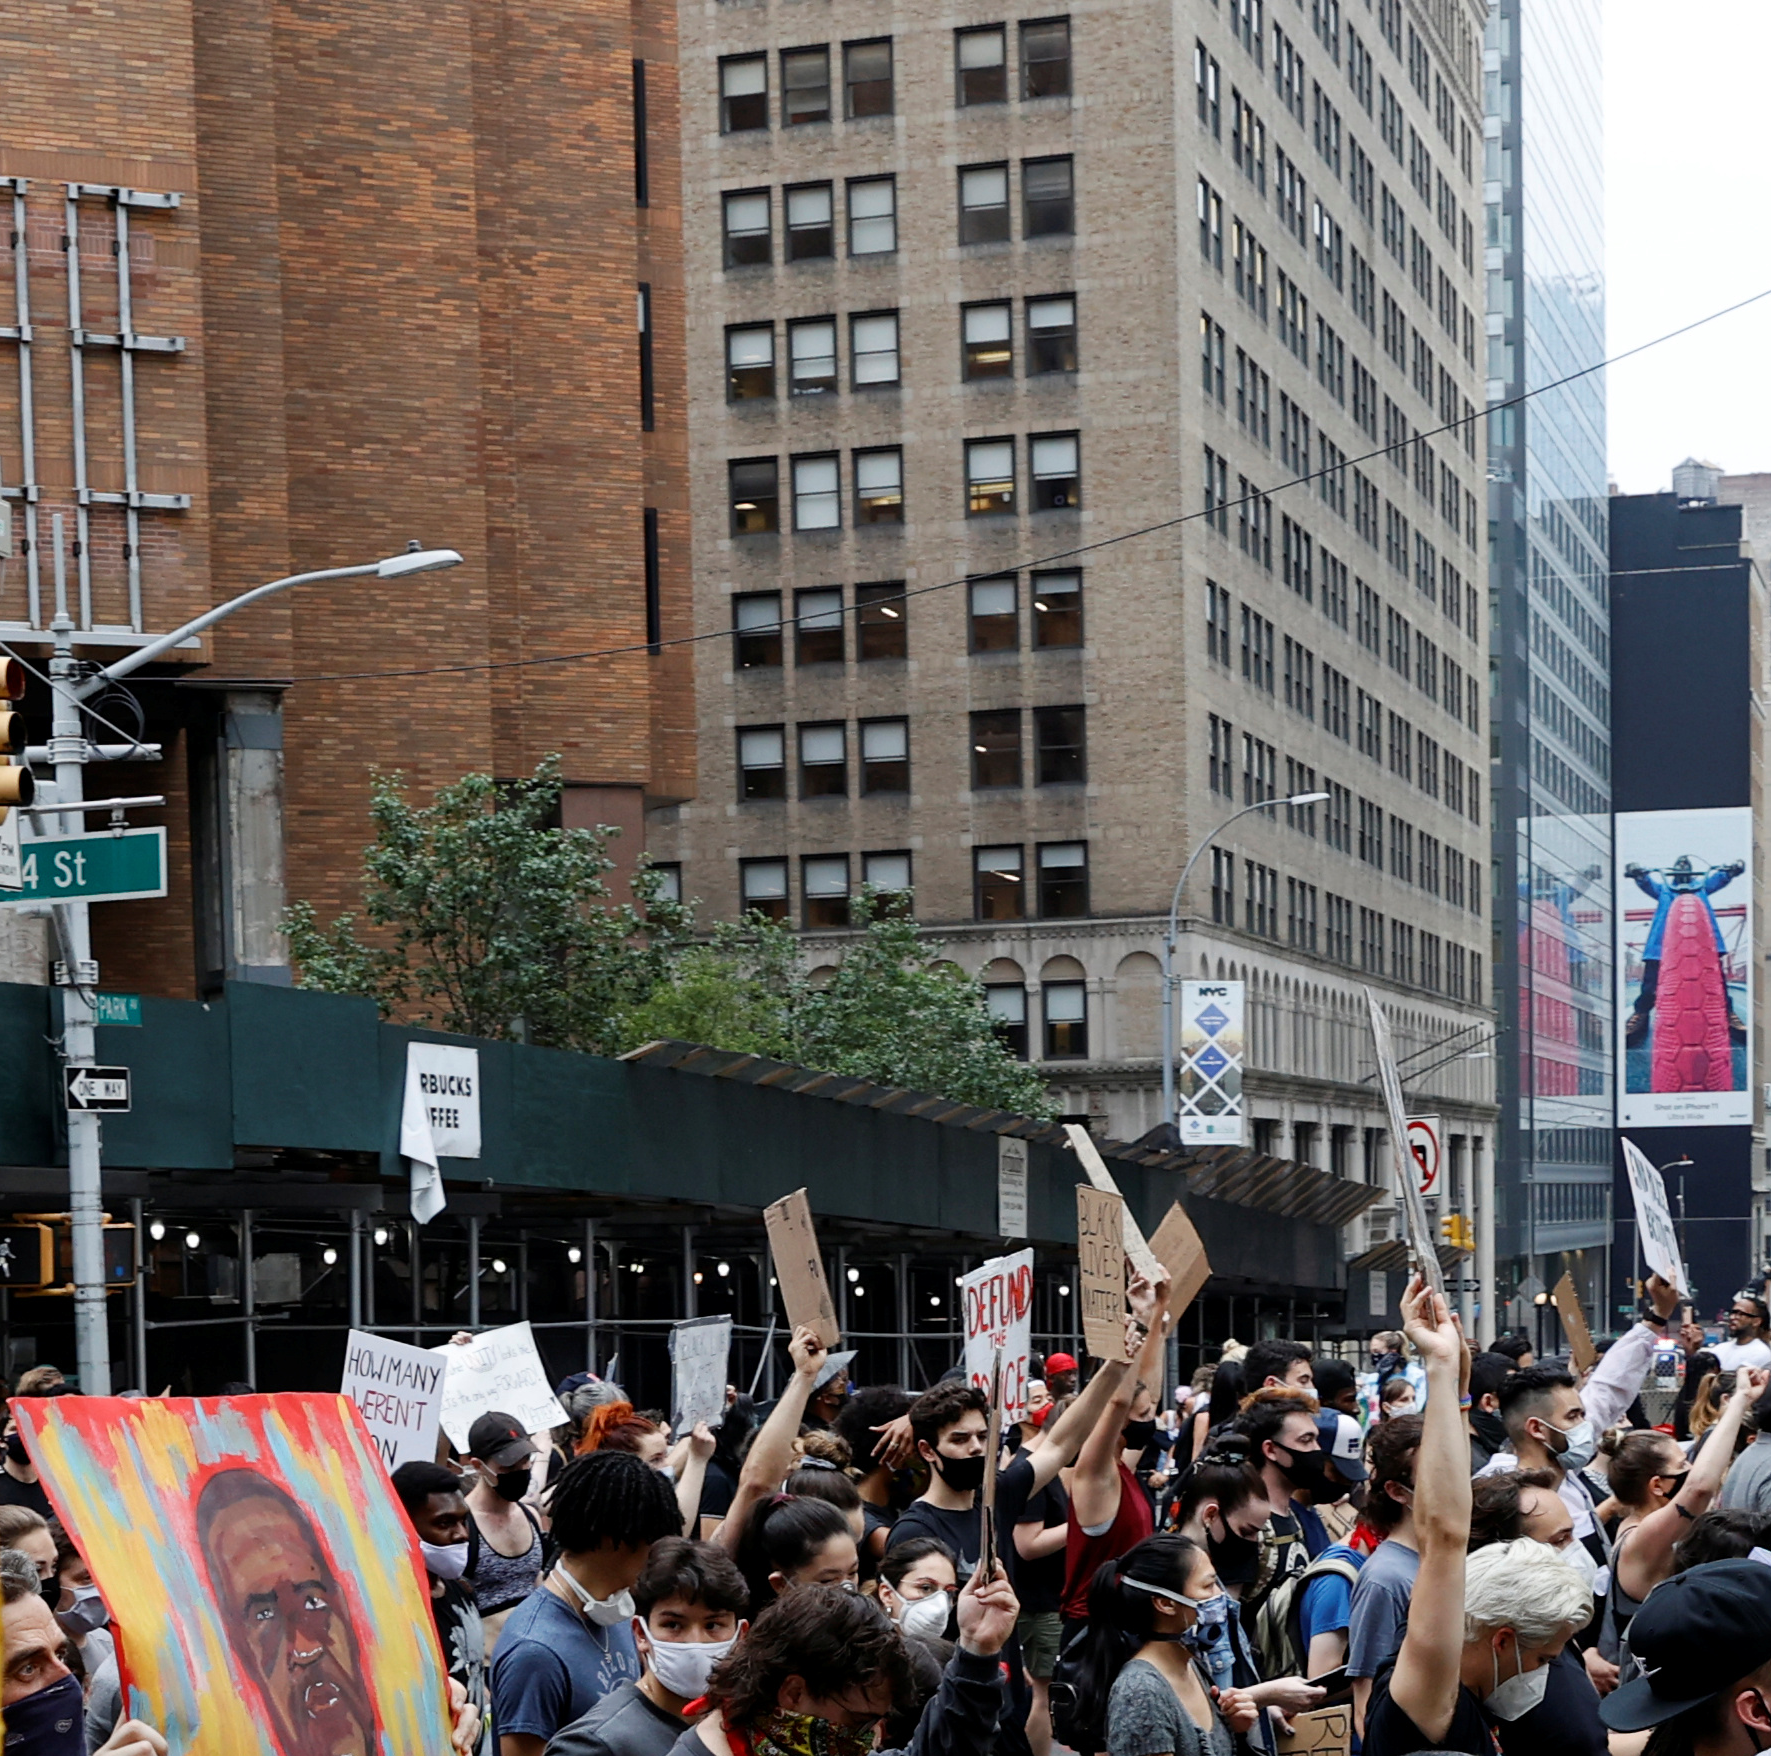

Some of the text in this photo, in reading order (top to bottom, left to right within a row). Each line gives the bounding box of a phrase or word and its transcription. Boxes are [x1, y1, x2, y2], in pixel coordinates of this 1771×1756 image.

[53, 850, 87, 887] St
[1198, 987, 1228, 997] NYC
[98, 994, 129, 1021] PARK
[79, 1081, 123, 1098] ONE WAY
[419, 1073, 472, 1097] RBUCKS
[427, 1107, 460, 1129] FFEE
[967, 1264, 1035, 1340] DEFUND
[988, 1329, 1007, 1350] THE
[347, 1346, 387, 1381] HOW
[385, 1358, 442, 1395] MANY
[971, 1355, 1027, 1412] POICE
[352, 1385, 428, 1432] WEREN'T
